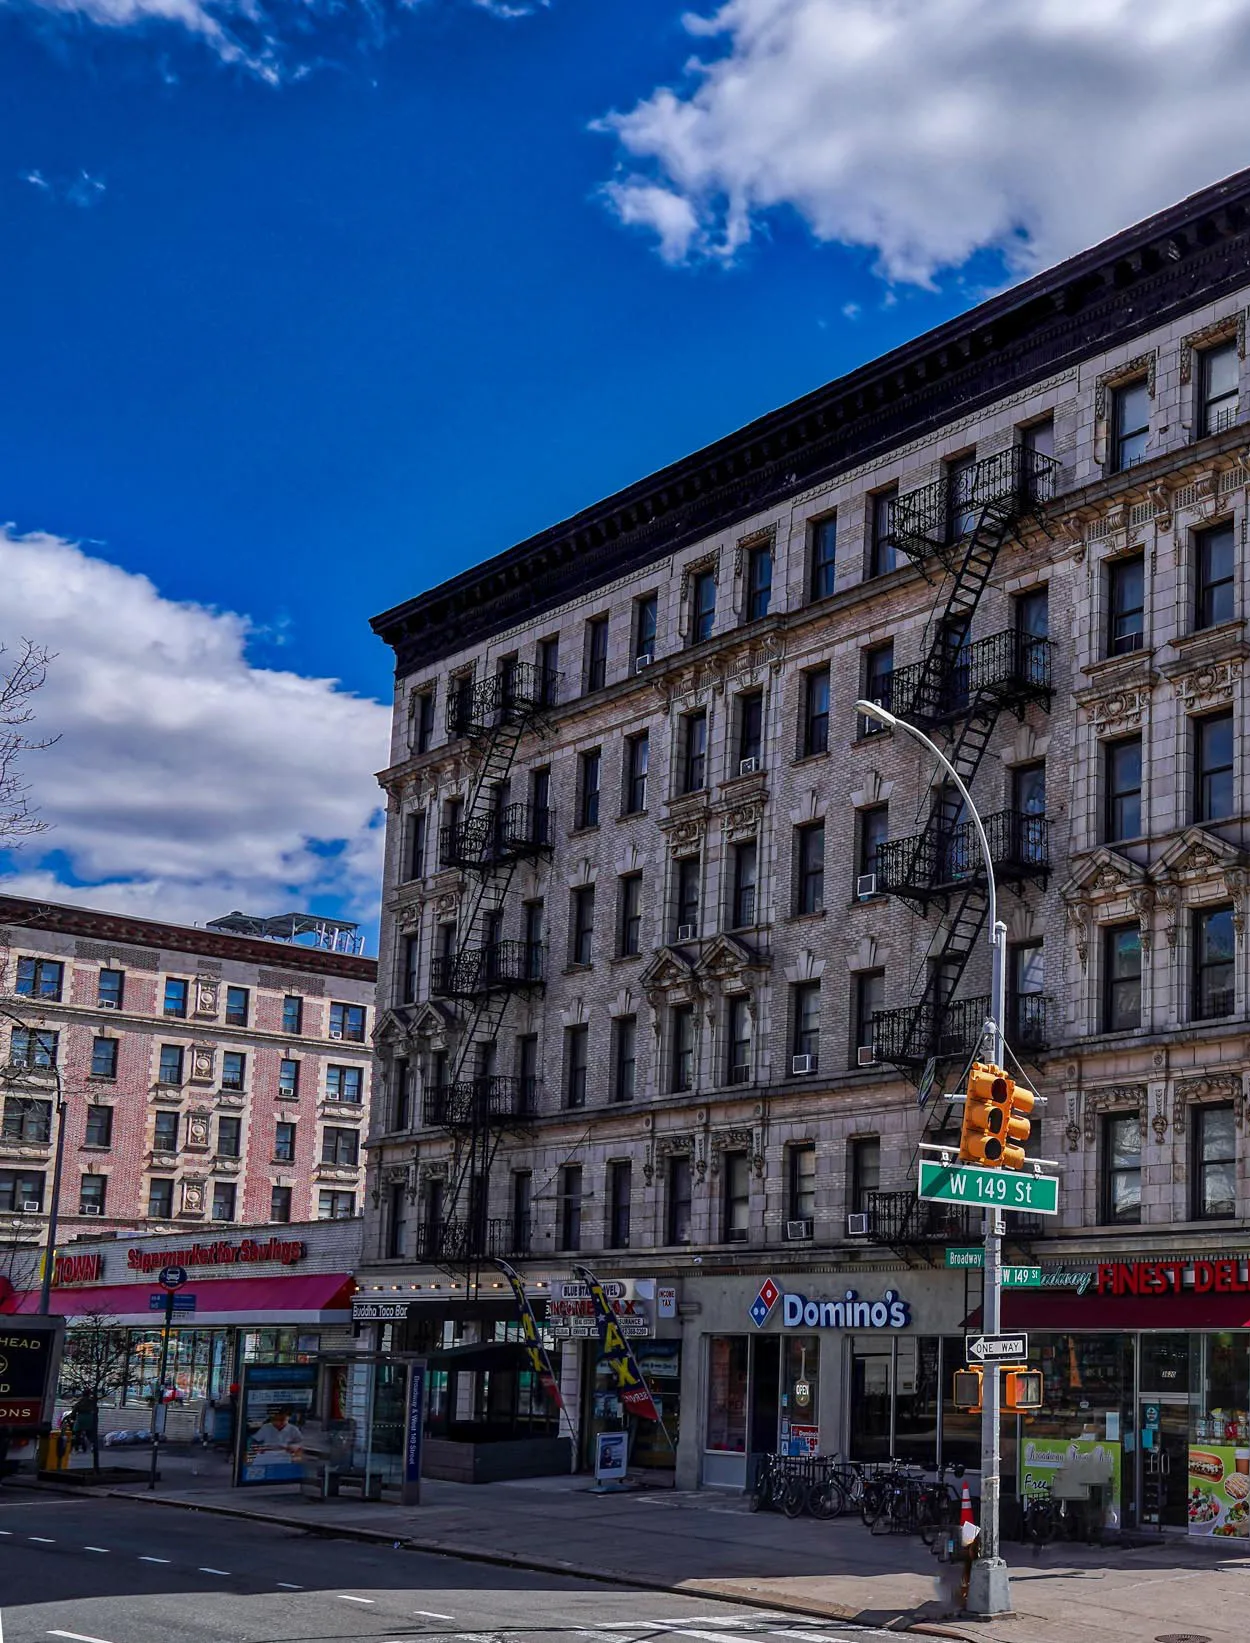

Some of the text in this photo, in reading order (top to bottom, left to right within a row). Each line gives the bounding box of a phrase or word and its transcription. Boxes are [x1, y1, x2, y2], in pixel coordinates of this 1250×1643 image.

[950, 1173, 1032, 1203] W 149 St
[128, 1237, 301, 1273] Supermarket for Savings
[950, 1252, 982, 1265] Broadway
[1003, 1270, 1038, 1283] W 149 St
[1041, 1266, 1092, 1295] adway
[1098, 1261, 1187, 1295] FINEST
[563, 1285, 577, 1297] BLUE
[579, 1284, 592, 1297] STA
[659, 1290, 675, 1298] INCOME
[353, 1304, 408, 1317] Buddha Taco Bar
[550, 1300, 595, 1316] INCOME
[612, 1300, 636, 1315] AX
[784, 1290, 905, 1328] Domino's
[591, 1285, 639, 1388] TAX
[976, 1342, 1019, 1353] ONE WAY
[796, 1385, 809, 1395] OPEN
[1025, 1473, 1049, 1490] Free
